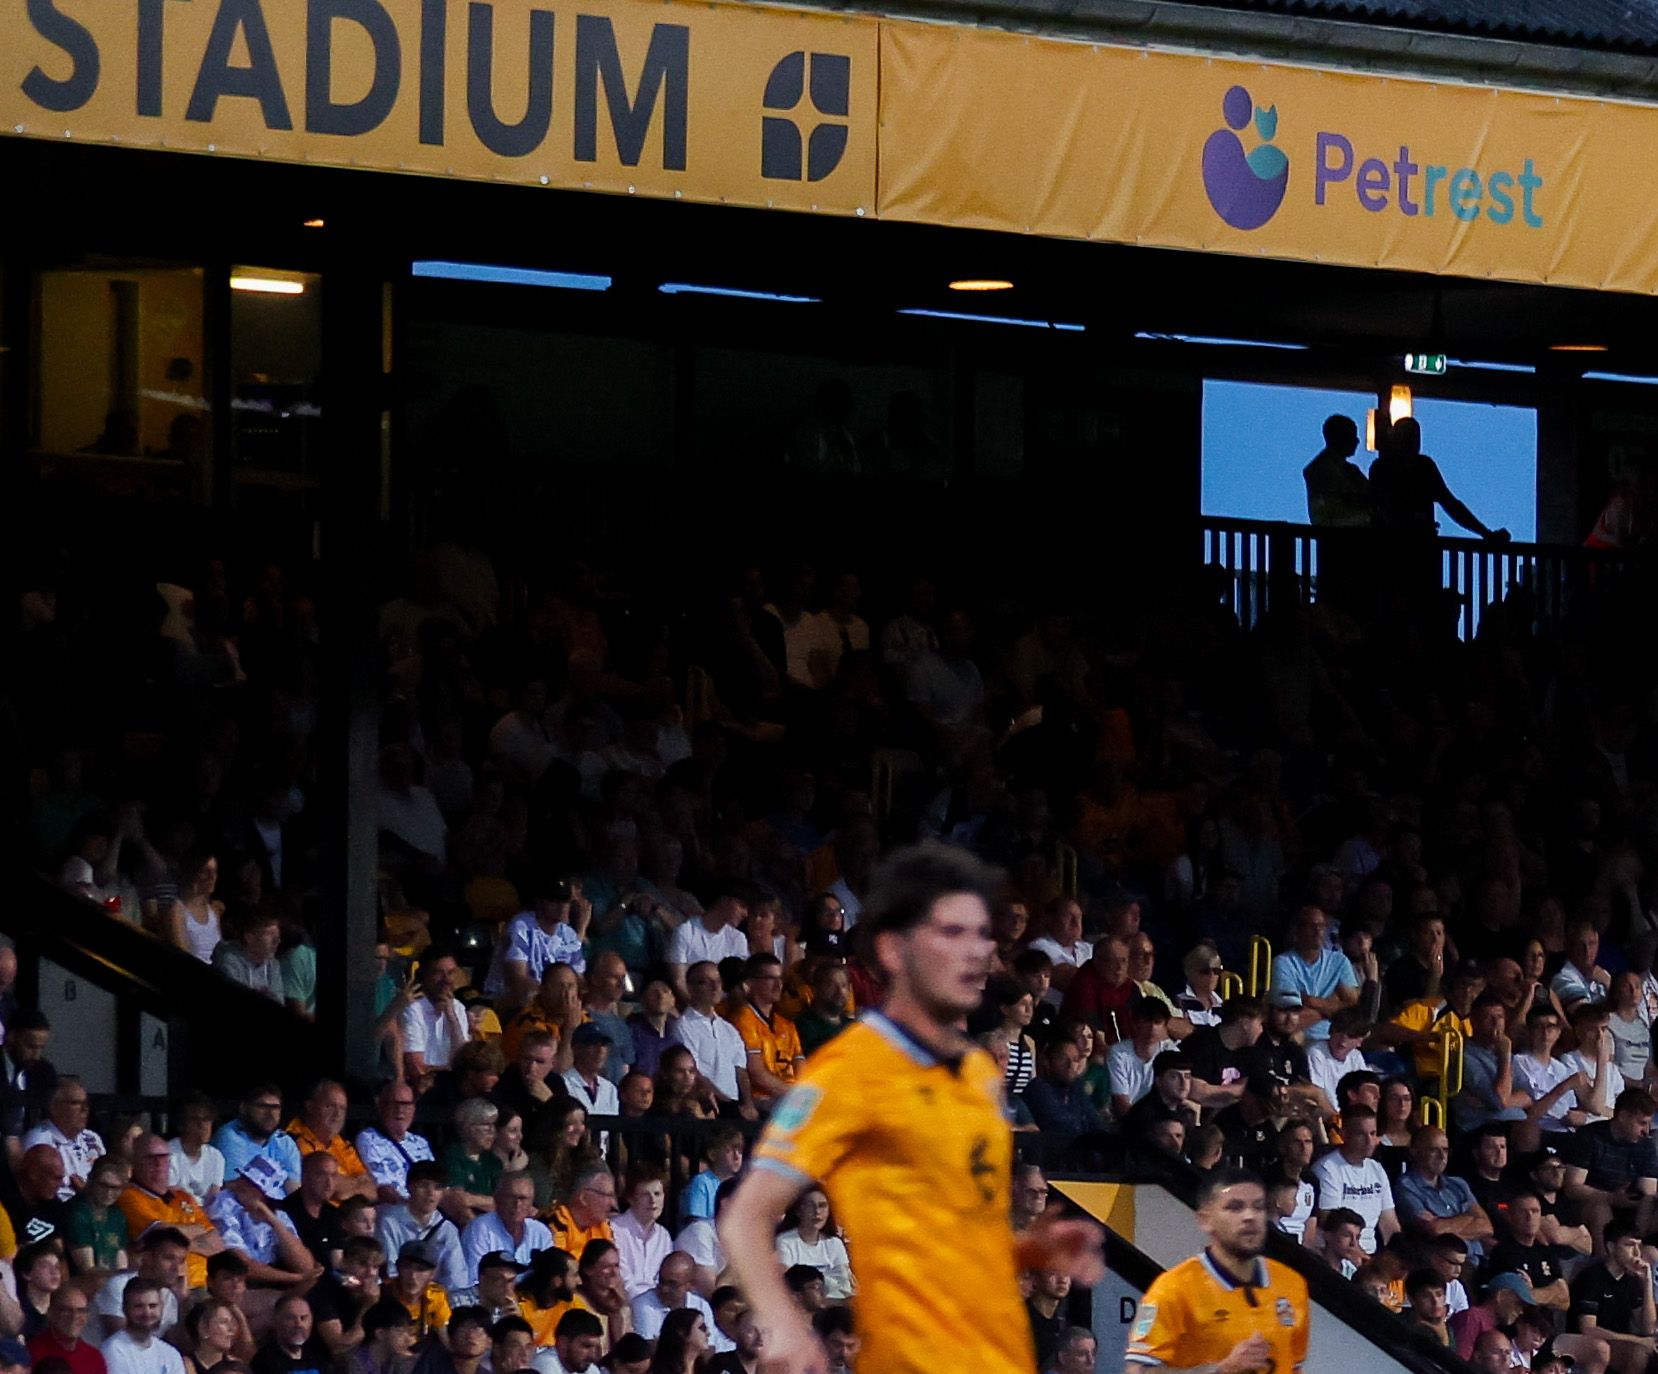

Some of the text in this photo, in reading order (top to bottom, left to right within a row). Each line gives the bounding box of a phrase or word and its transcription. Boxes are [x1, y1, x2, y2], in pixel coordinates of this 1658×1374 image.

[20, 0, 690, 171] STADIUM
[1314, 131, 1544, 228] Petrest
[1120, 1296, 1137, 1324] D
